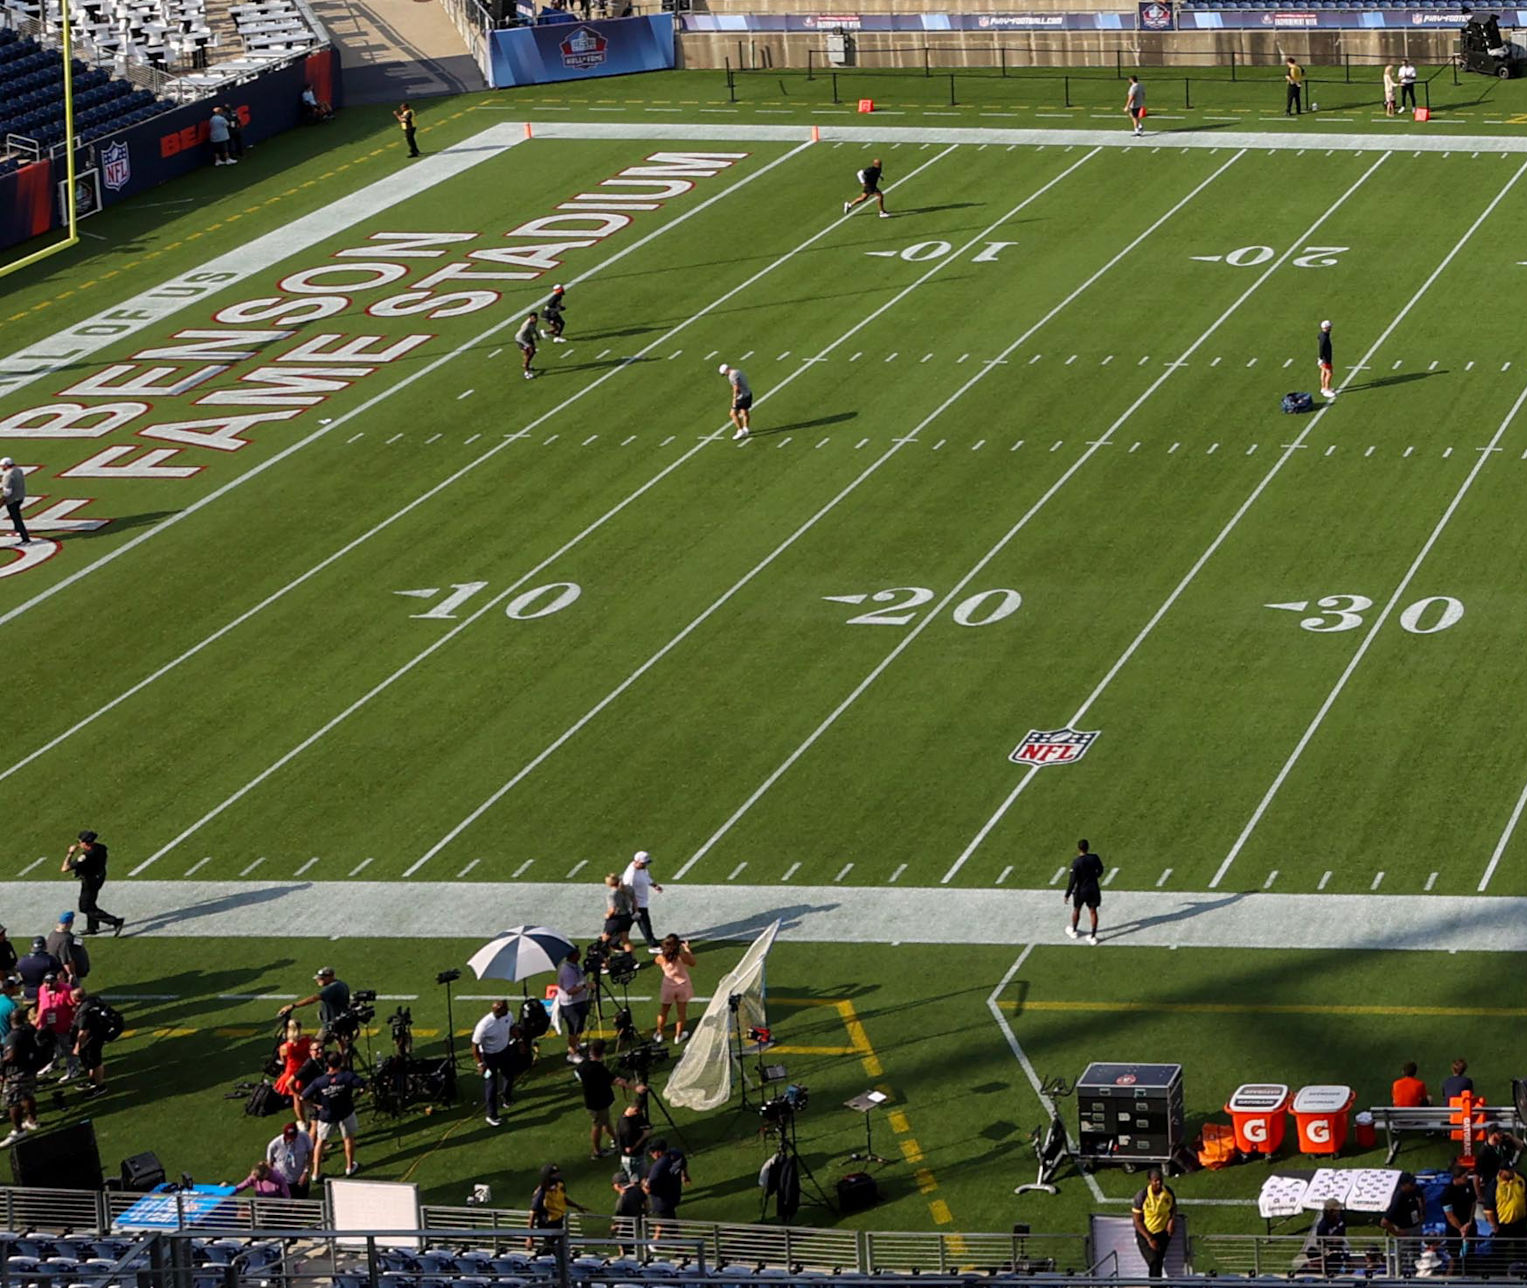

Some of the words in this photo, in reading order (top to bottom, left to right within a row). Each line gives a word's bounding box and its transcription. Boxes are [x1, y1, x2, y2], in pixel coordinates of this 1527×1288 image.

[106, 161, 127, 183] NFL
[55, 332, 438, 479] FAME
[366, 150, 749, 318] STADIUM
[72, 309, 155, 336] OF
[147, 271, 239, 299] US
[0, 231, 481, 439] BENSON
[1019, 744, 1077, 763] NFL
[1243, 1118, 1267, 1143] G
[1306, 1119, 1330, 1143] G
[1463, 1117, 1472, 1157] GATORADE
